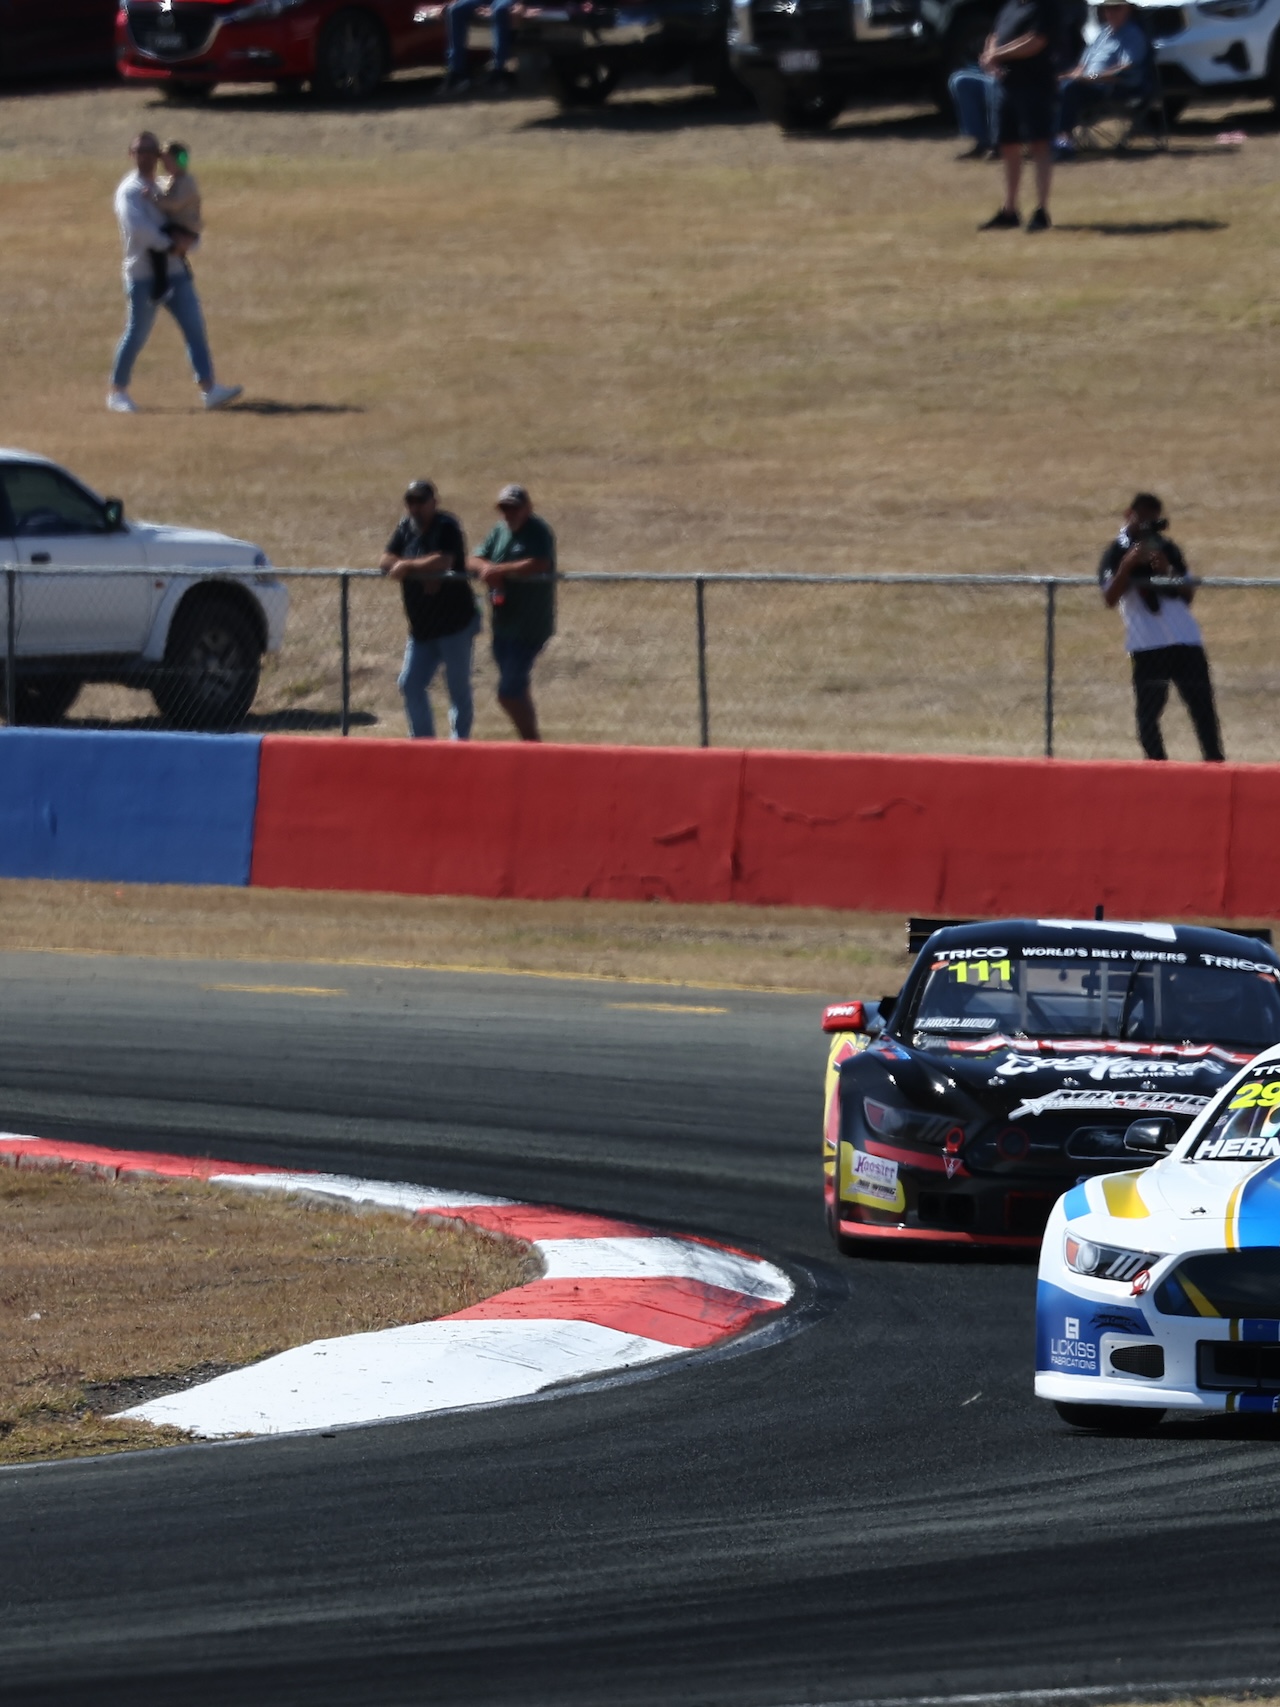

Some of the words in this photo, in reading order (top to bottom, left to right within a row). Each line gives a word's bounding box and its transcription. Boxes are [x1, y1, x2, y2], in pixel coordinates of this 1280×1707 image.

[934, 946, 1009, 961] TRICO
[1022, 947, 1088, 957] WORLD'S
[1091, 949, 1128, 959] BEST
[1130, 950, 1187, 964] WIPERS
[1199, 953, 1275, 974] TRICO
[948, 960, 1011, 983] 111
[854, 1154, 896, 1179] Hoosier
[1050, 1338, 1096, 1359] LICKISS
[1050, 1356, 1097, 1370] FABRICATIONS
